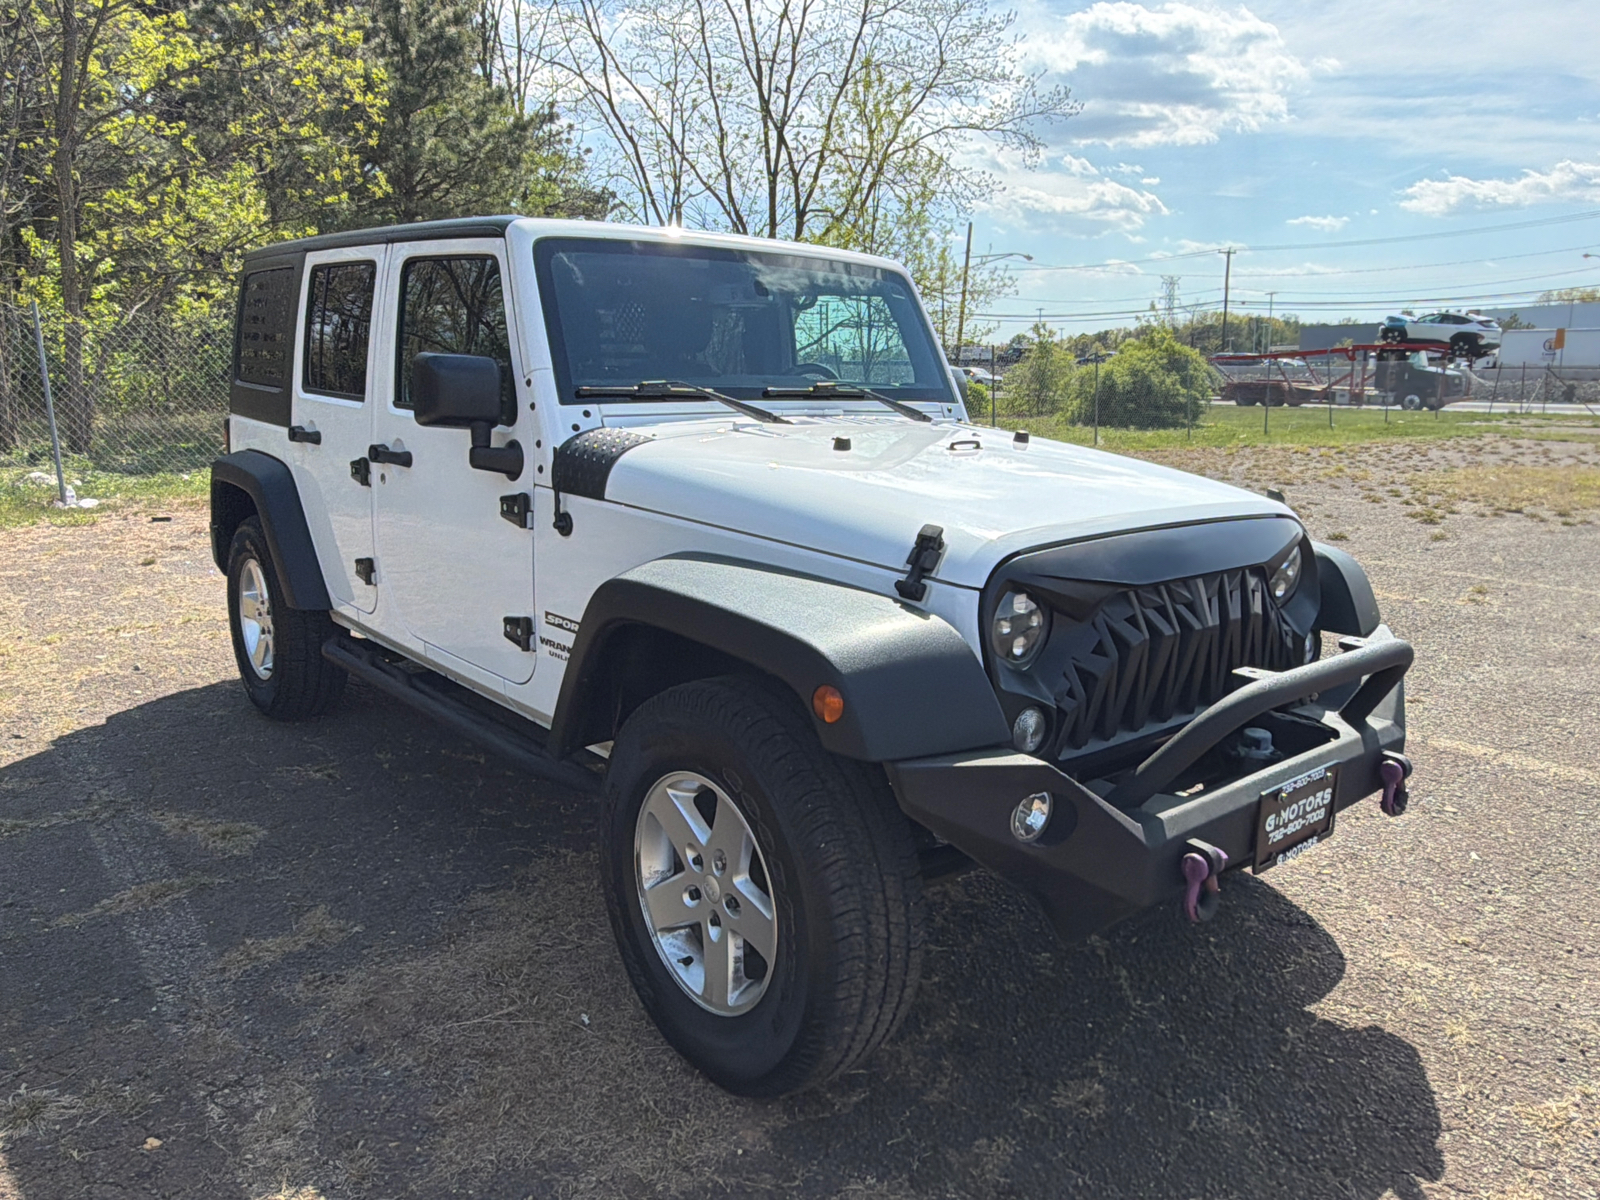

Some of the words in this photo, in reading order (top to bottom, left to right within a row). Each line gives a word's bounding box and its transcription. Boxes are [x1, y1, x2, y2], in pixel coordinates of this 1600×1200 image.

[546, 613, 580, 632] SPOR
[539, 635, 572, 654] WRAN
[548, 650, 568, 662] UNLI
[1268, 807, 1326, 845] 732-800-7003
